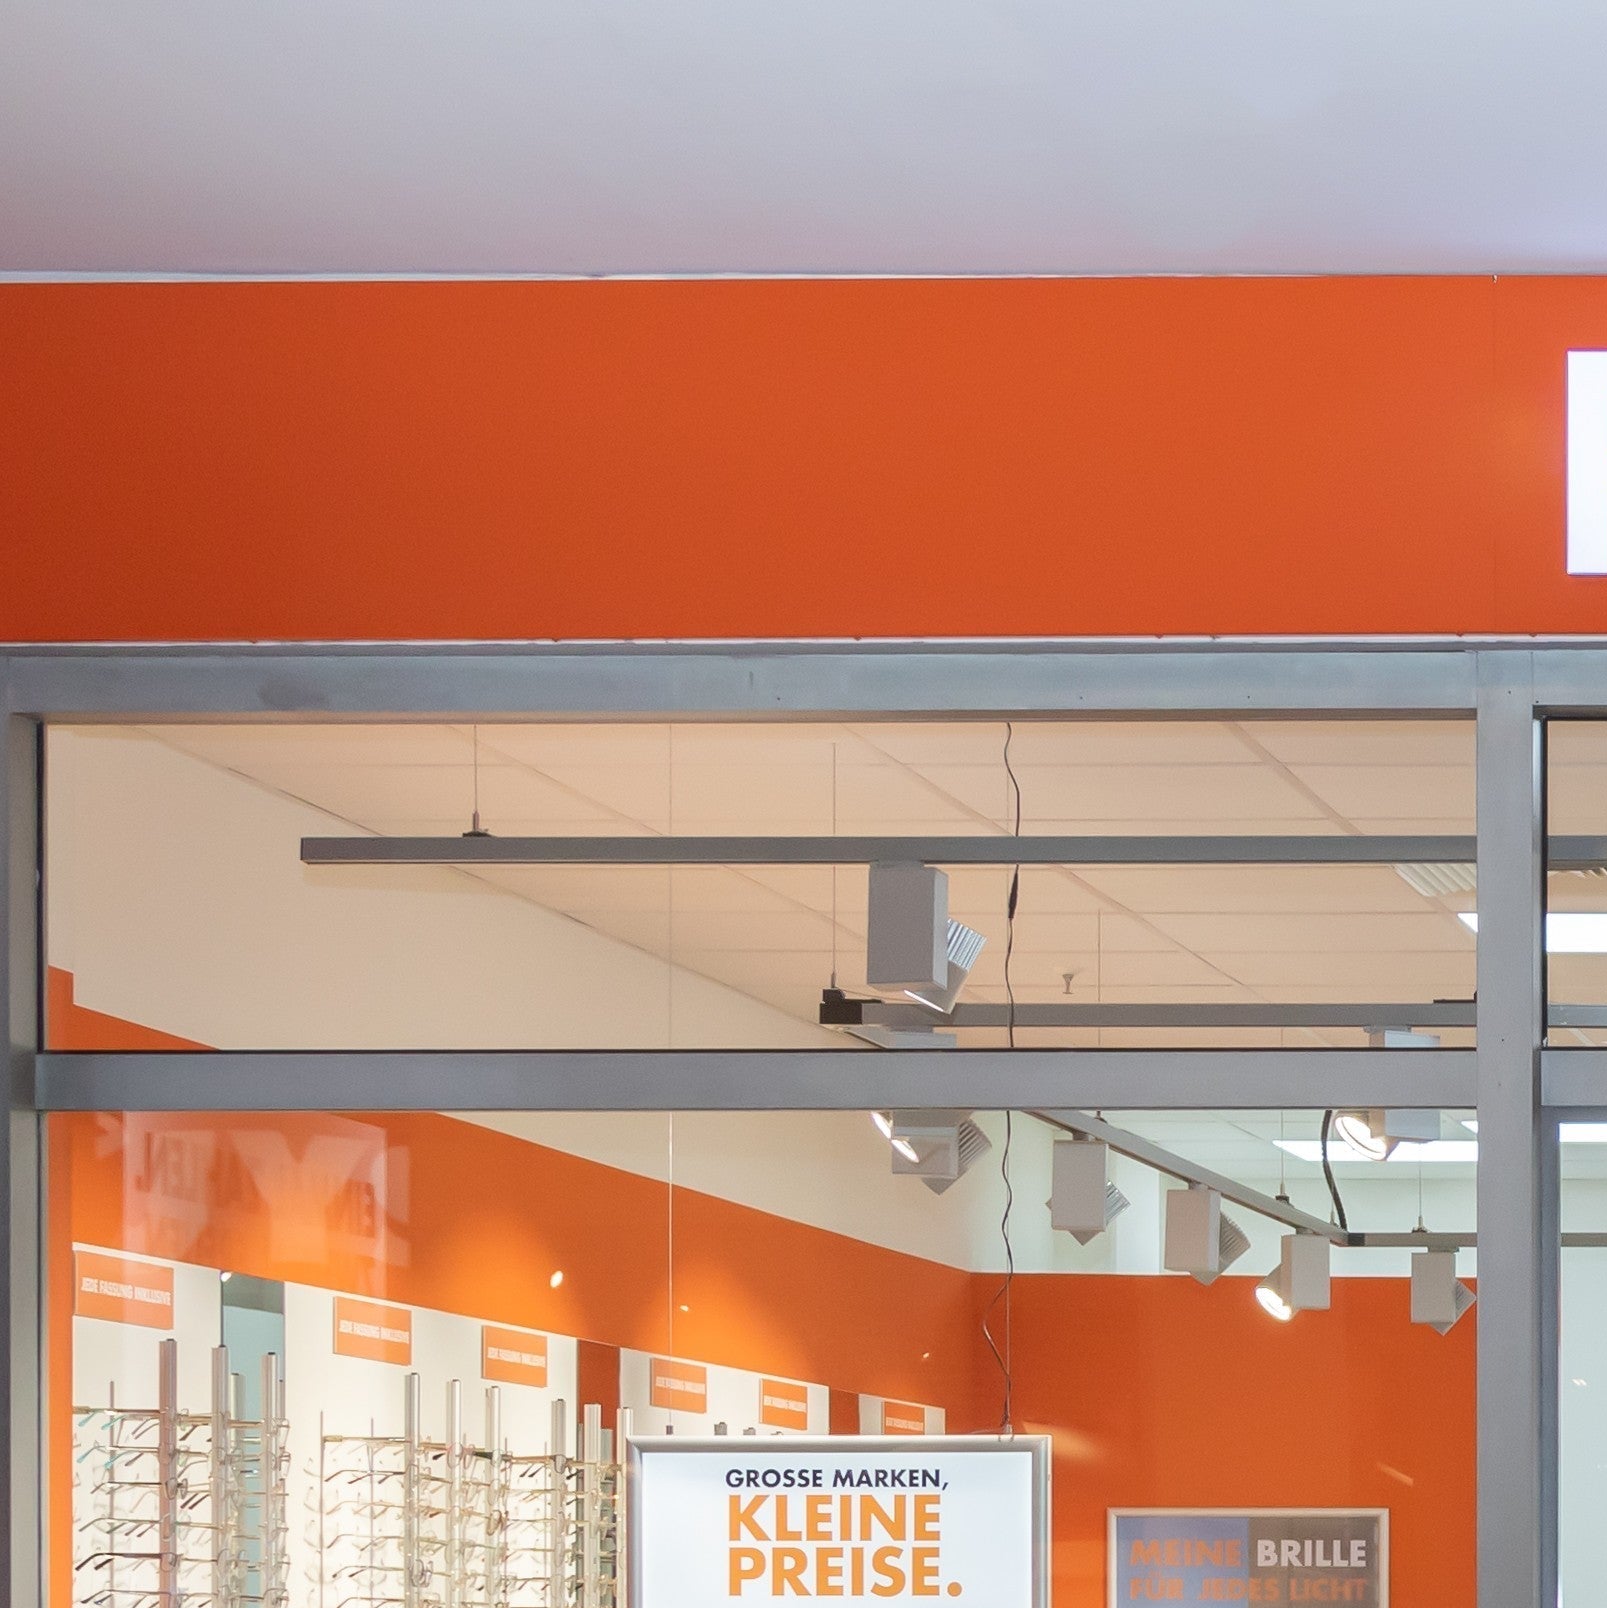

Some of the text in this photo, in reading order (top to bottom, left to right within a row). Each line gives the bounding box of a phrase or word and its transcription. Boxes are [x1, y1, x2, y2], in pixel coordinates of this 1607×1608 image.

[99, 1280, 133, 1299] FASSUNG
[726, 1469, 949, 1491] GROSSE MARKEN,
[729, 1495, 941, 1541] KLEINE
[1129, 1539, 1367, 1567] MEINE BRILLE
[729, 1547, 962, 1597] PREISE.
[1129, 1573, 1368, 1600] FÜR JEDES LICHT
